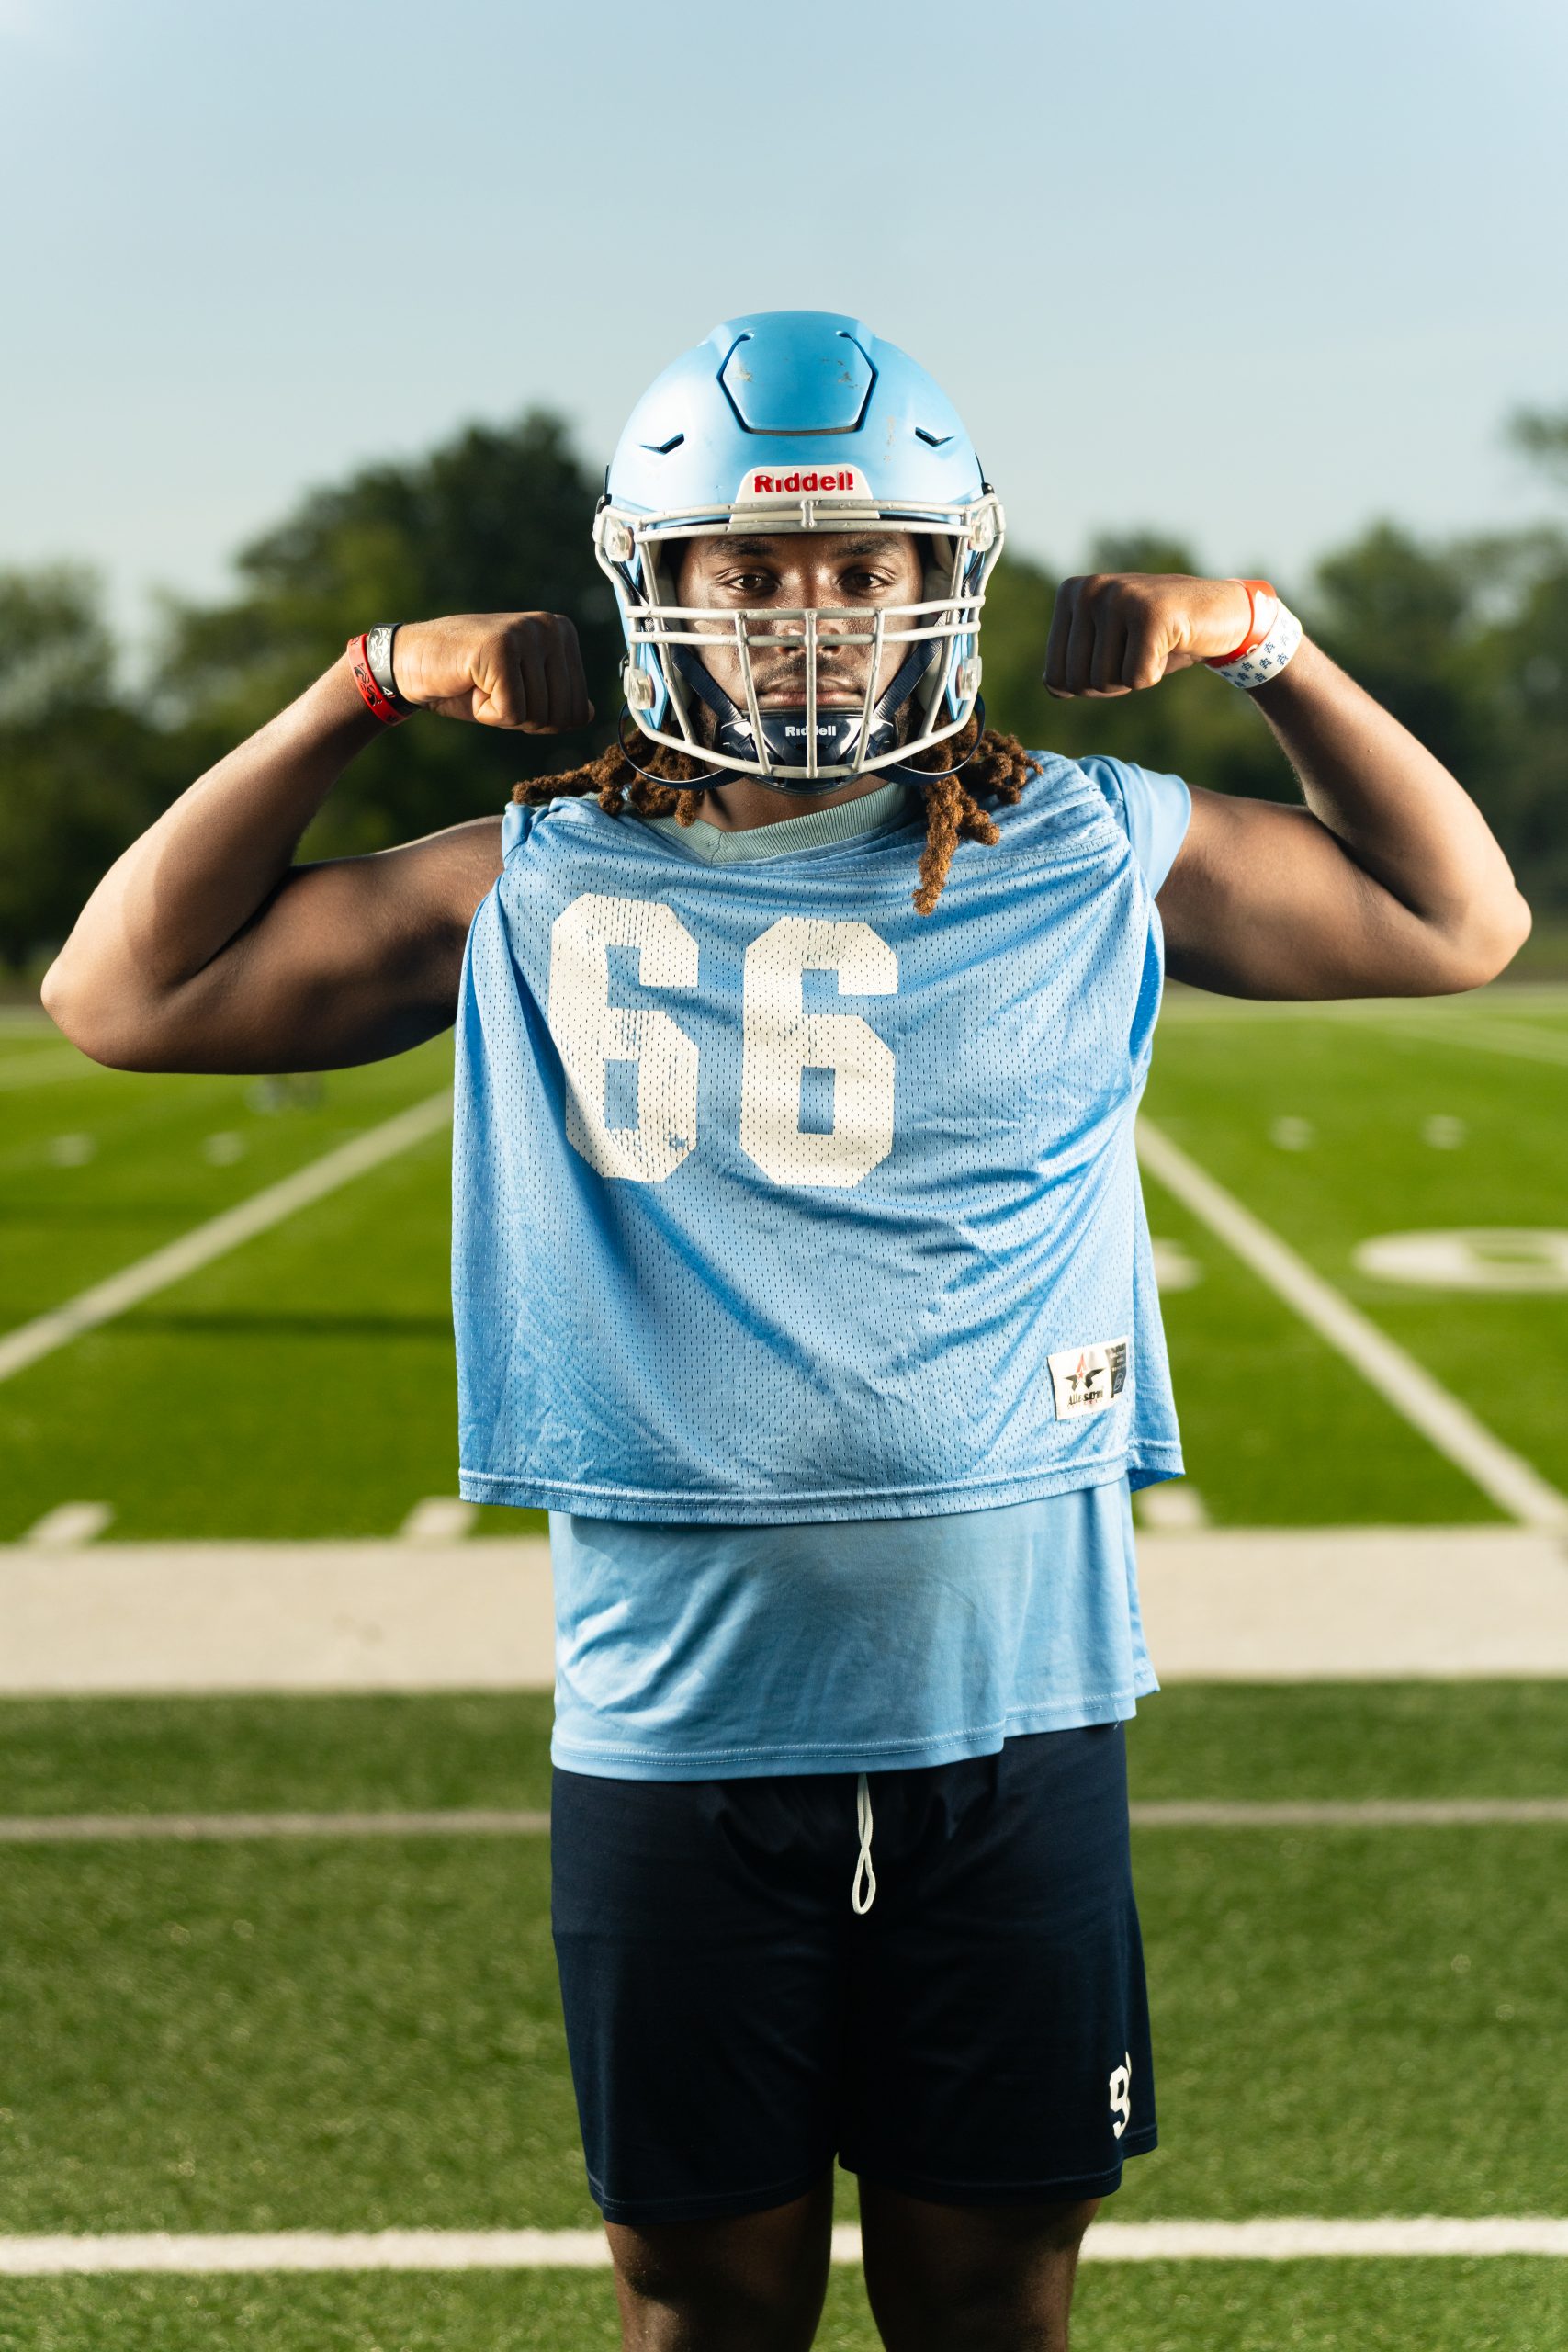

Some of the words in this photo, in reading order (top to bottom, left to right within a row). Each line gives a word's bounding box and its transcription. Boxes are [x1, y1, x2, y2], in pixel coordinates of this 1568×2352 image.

[754, 471, 854, 493] Riddell
[784, 726, 837, 737] Ridell
[548, 892, 897, 1188] 66
